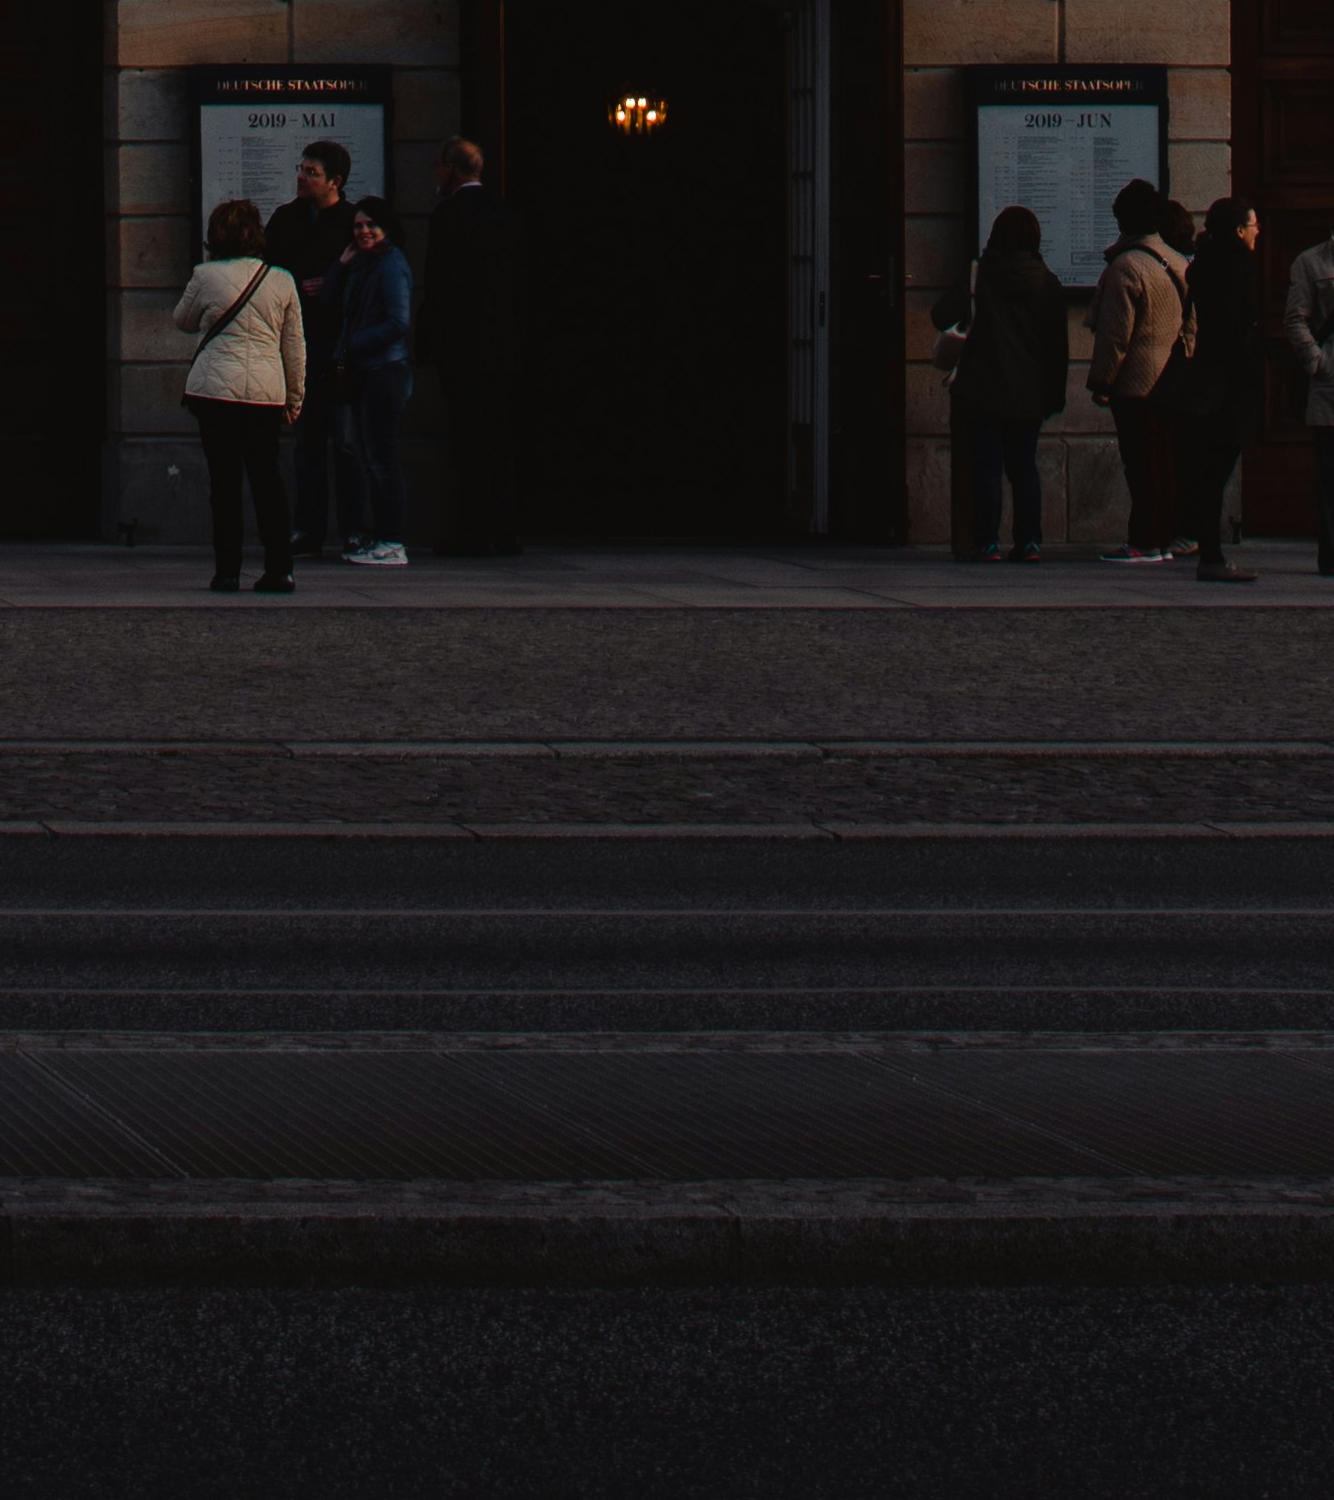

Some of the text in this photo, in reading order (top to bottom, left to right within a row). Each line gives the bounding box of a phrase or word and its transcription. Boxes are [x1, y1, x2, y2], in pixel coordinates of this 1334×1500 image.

[216, 78, 368, 92] DEUTSCHE STAATSOPER
[994, 78, 1145, 92] DEUTSCHE STAATSOPER
[247, 113, 287, 129] 2019
[302, 113, 336, 128] MAI
[1024, 113, 1062, 129] 2019
[1077, 113, 1113, 128] JUN
